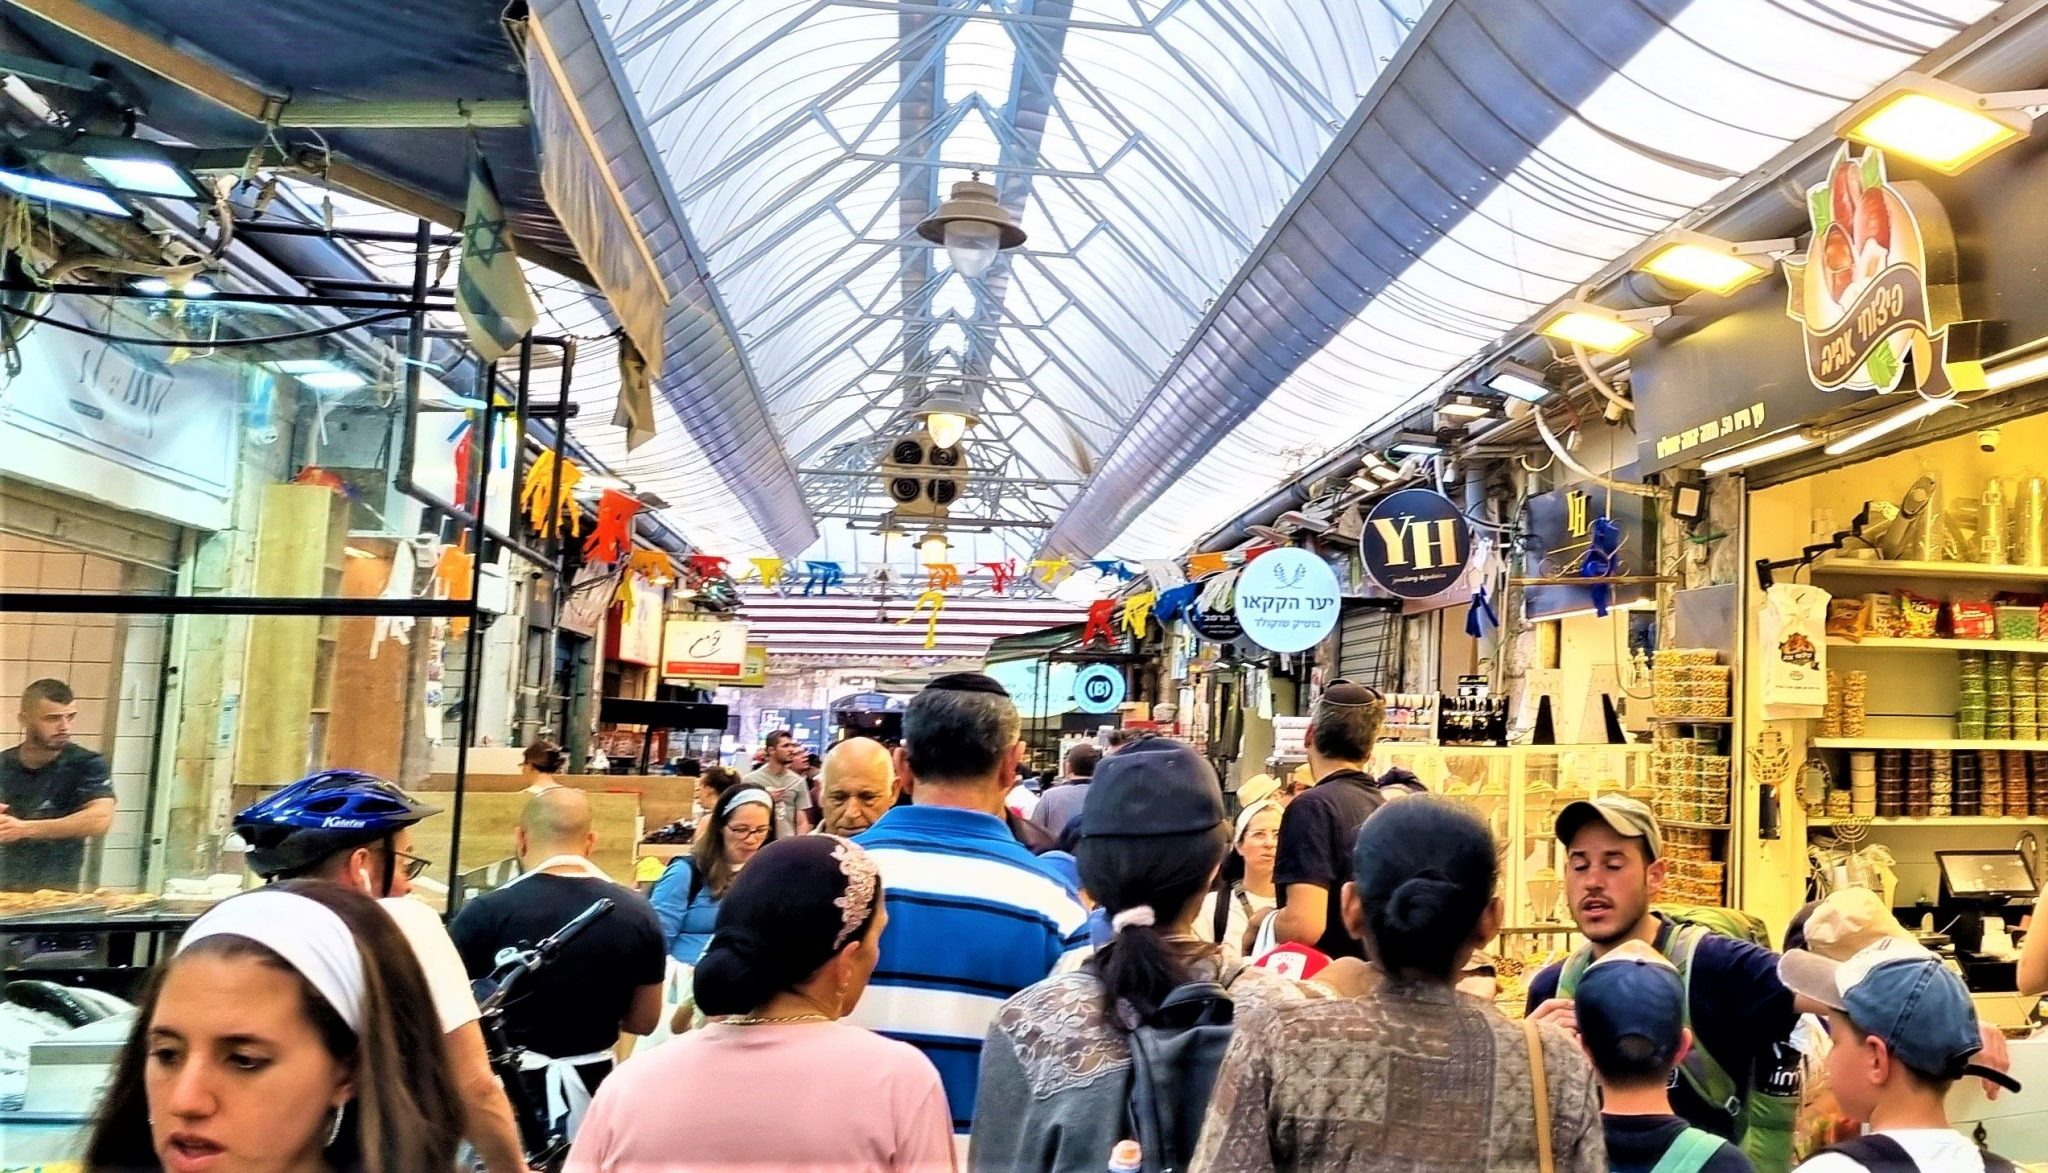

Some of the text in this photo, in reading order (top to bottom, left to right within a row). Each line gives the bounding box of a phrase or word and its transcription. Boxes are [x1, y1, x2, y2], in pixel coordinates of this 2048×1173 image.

[1857, 283, 1904, 342] פיצוחי
[1369, 514, 1461, 570] YH
[1242, 595, 1334, 614] יער הקקאו
